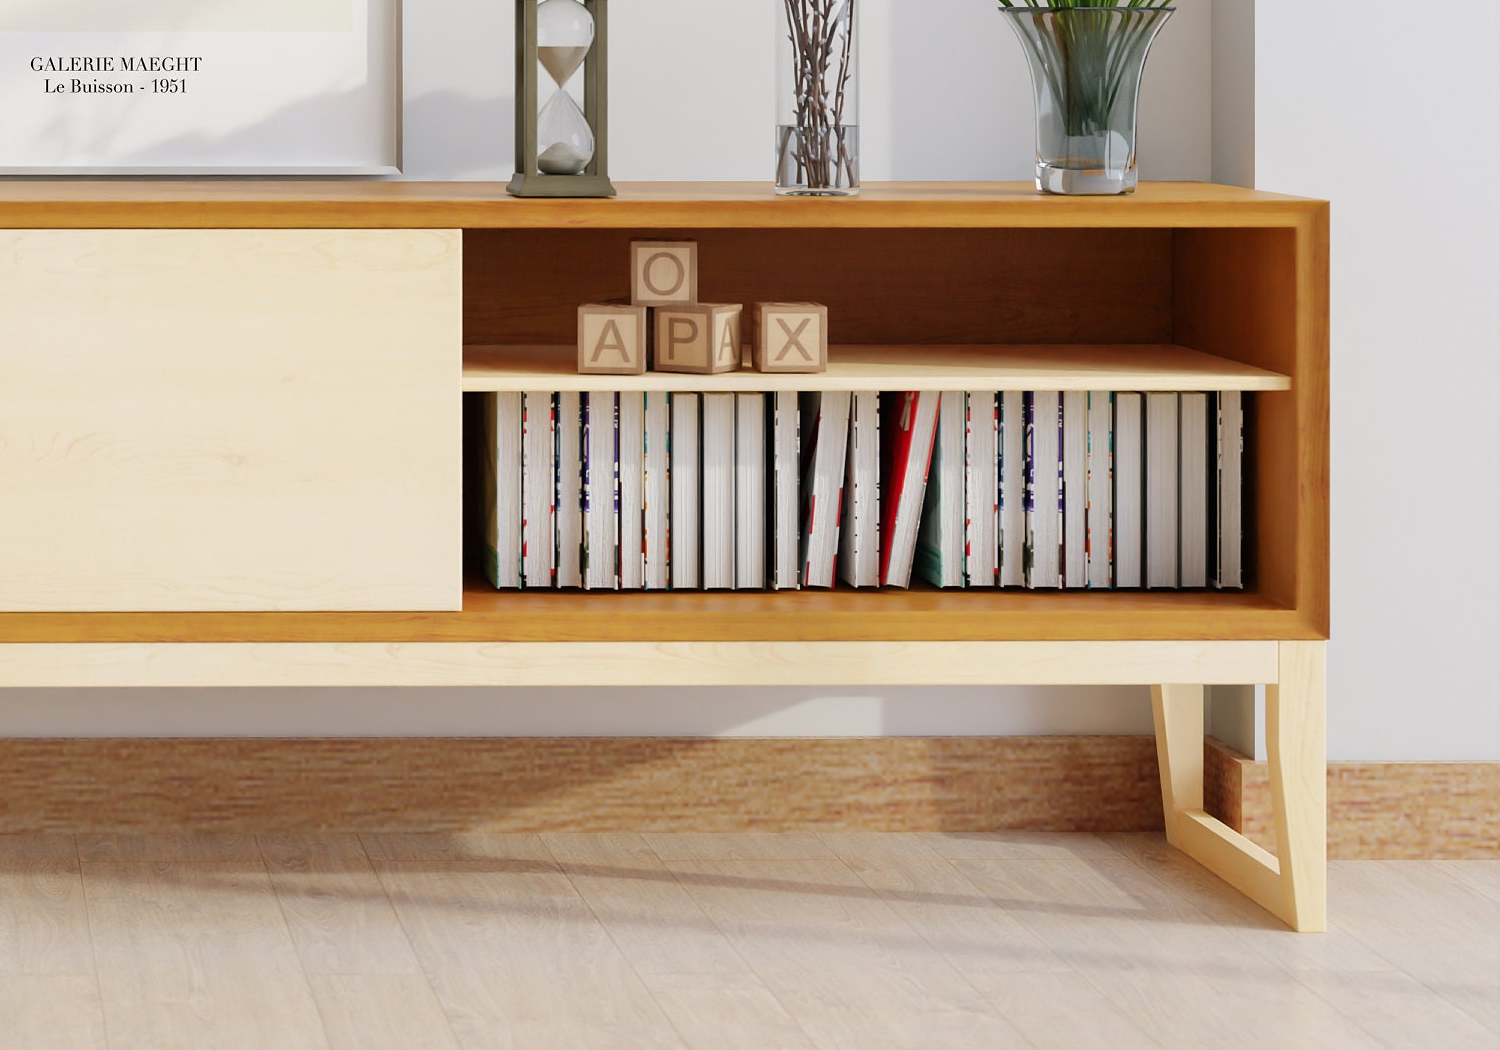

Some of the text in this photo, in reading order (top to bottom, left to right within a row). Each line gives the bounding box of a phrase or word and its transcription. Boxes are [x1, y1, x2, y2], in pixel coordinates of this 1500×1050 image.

[30, 56, 203, 72] GALERIE MAEGHT
[43, 78, 65, 94] Le
[70, 78, 134, 94] Buisson
[151, 78, 187, 94] 1951
[642, 251, 685, 296] O
[590, 318, 631, 363] A
[668, 317, 699, 361] P
[718, 317, 737, 362] A
[775, 317, 814, 362] X
